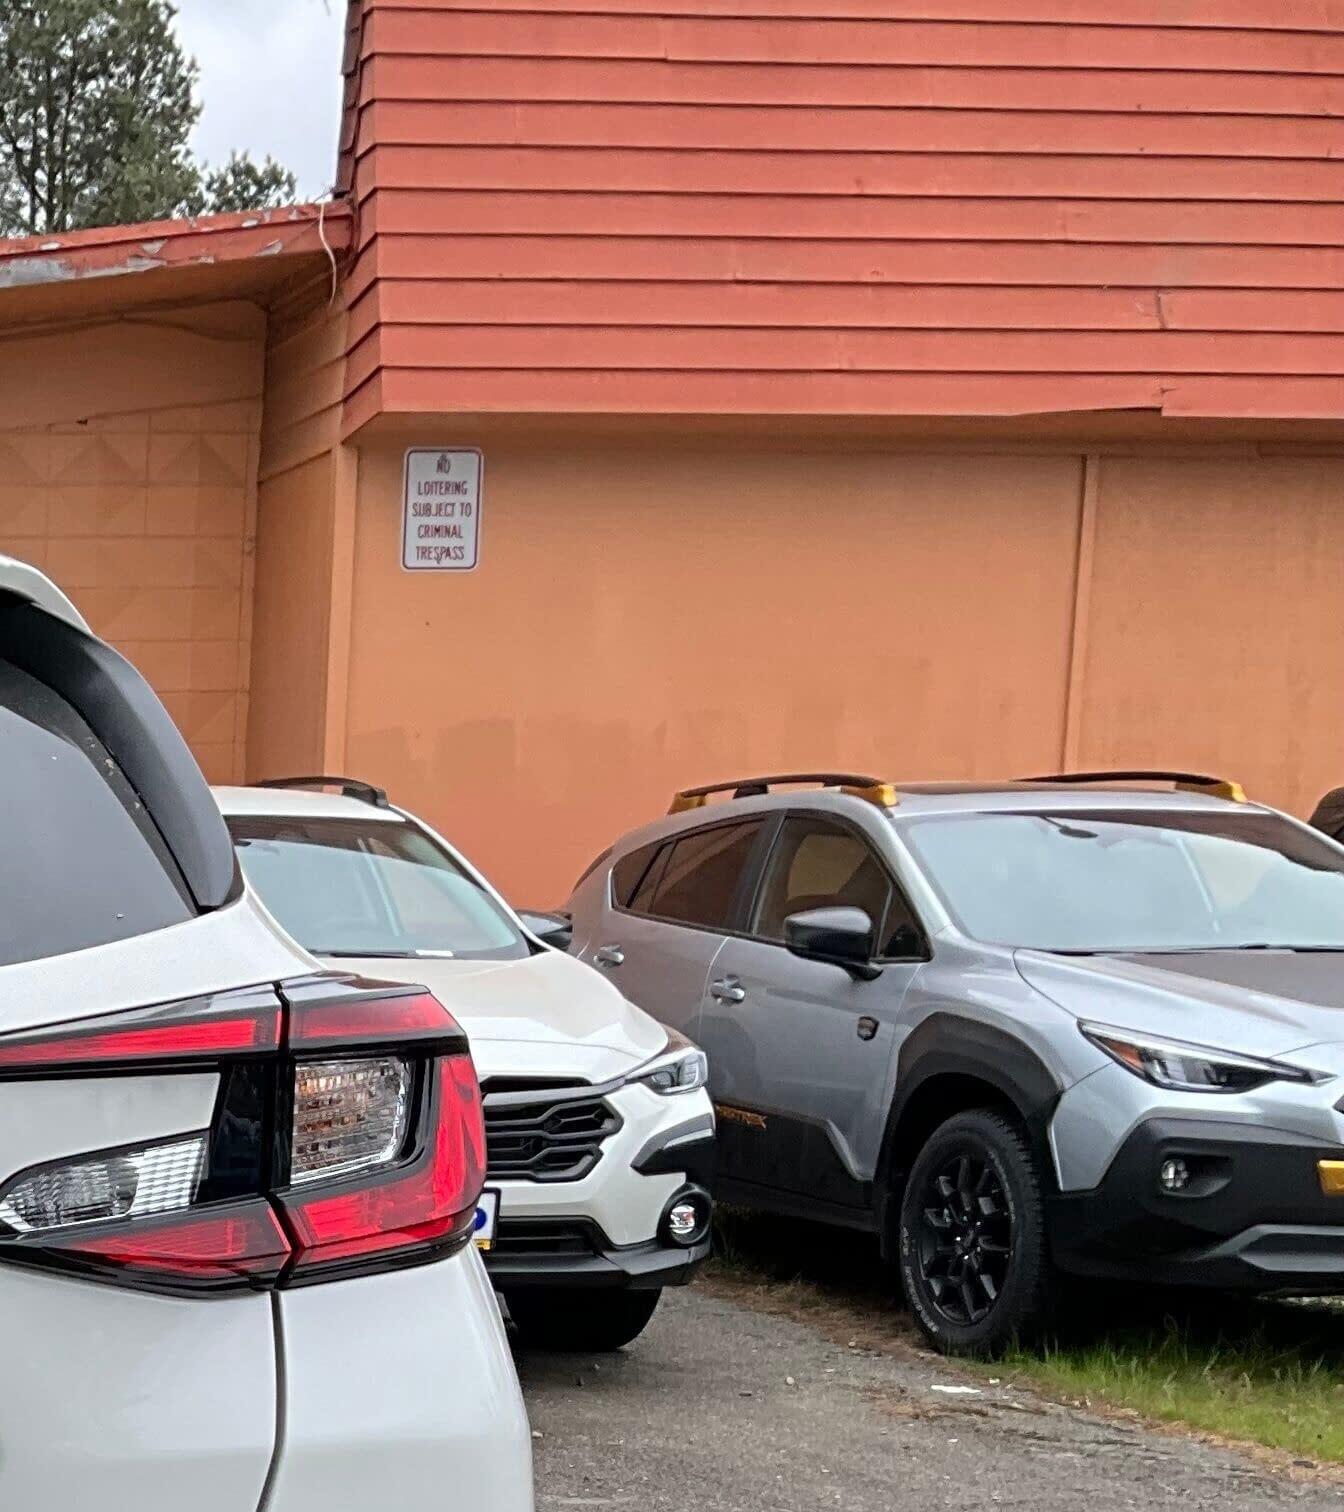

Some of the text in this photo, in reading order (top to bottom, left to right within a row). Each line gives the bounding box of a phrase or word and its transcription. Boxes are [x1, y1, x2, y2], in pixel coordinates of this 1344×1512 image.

[436, 460, 451, 474] NO
[417, 480, 468, 496] LOITERING
[412, 502, 472, 517] SUBJECT TO
[417, 524, 464, 539] CRIMINAL
[415, 545, 465, 561] TRESPASS
